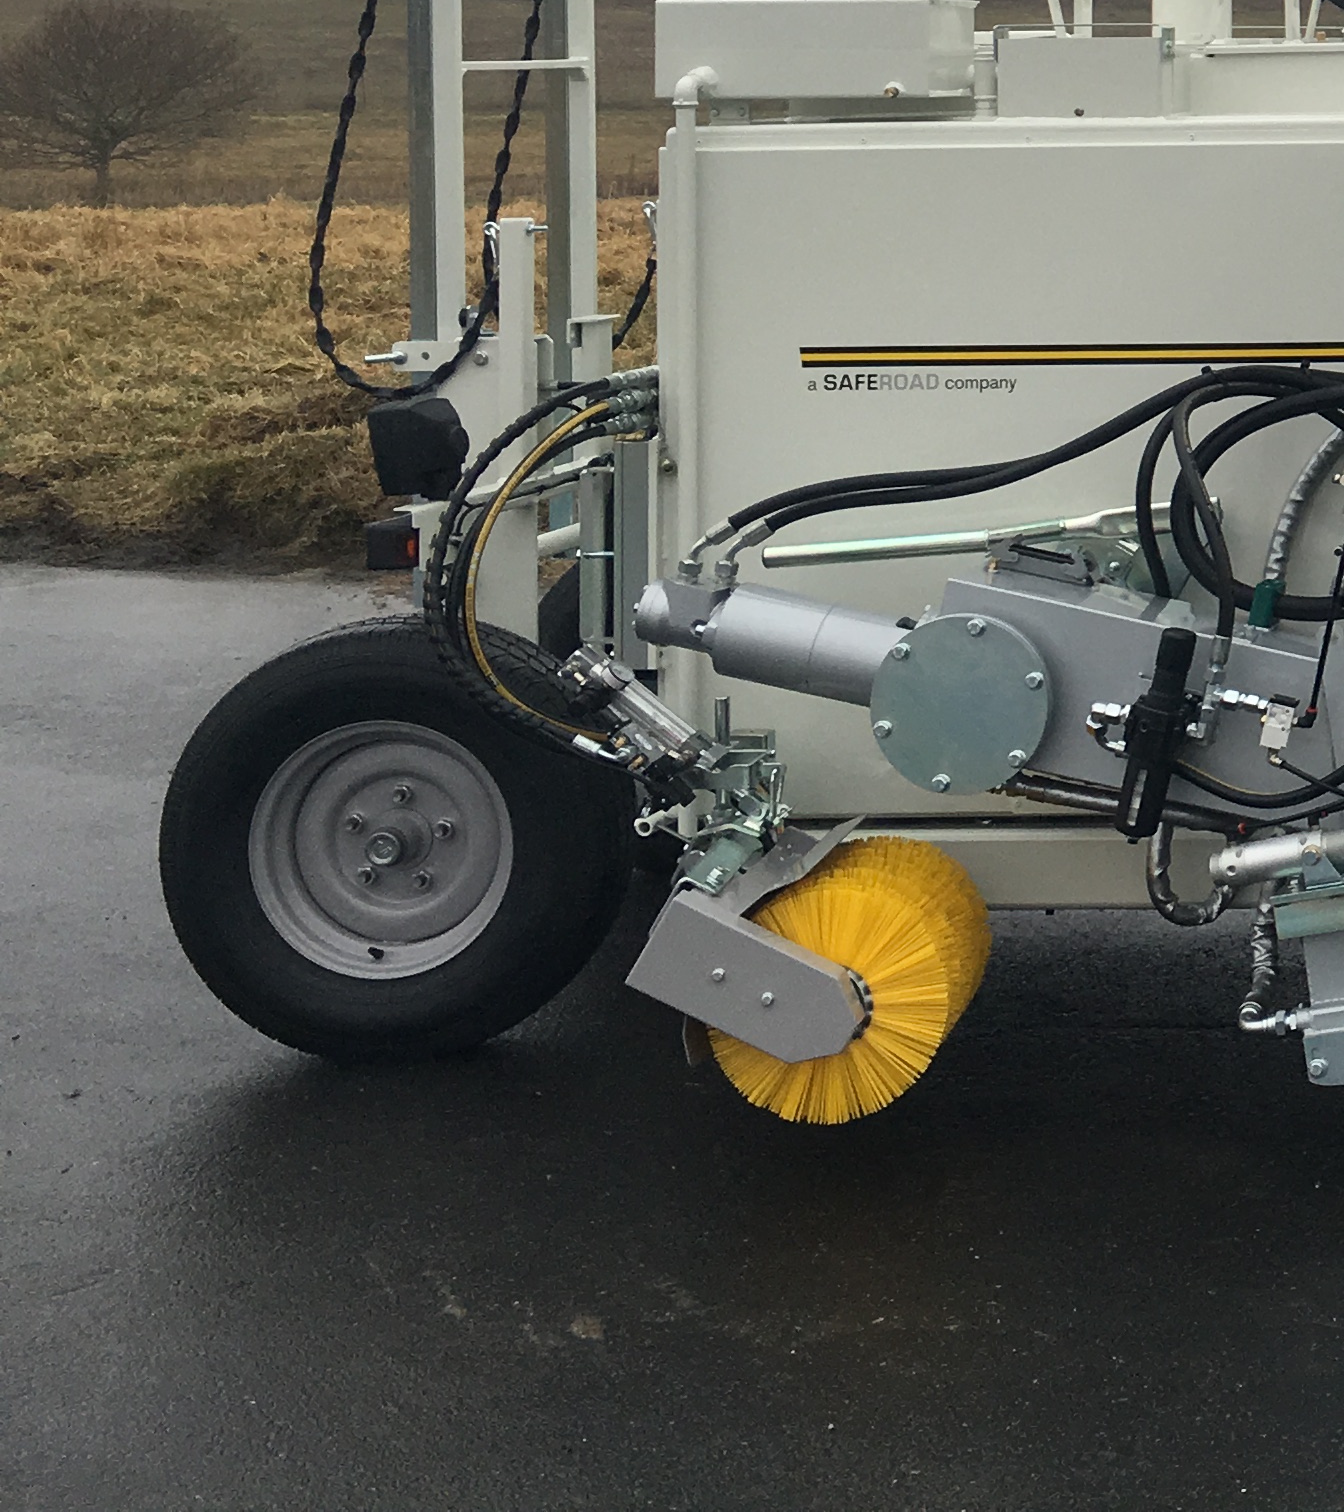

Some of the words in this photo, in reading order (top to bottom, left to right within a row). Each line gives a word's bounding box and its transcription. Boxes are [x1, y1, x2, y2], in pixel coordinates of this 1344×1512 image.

[807, 380, 817, 392] a
[823, 373, 940, 392] SAFEROAD
[944, 378, 1017, 393] company
